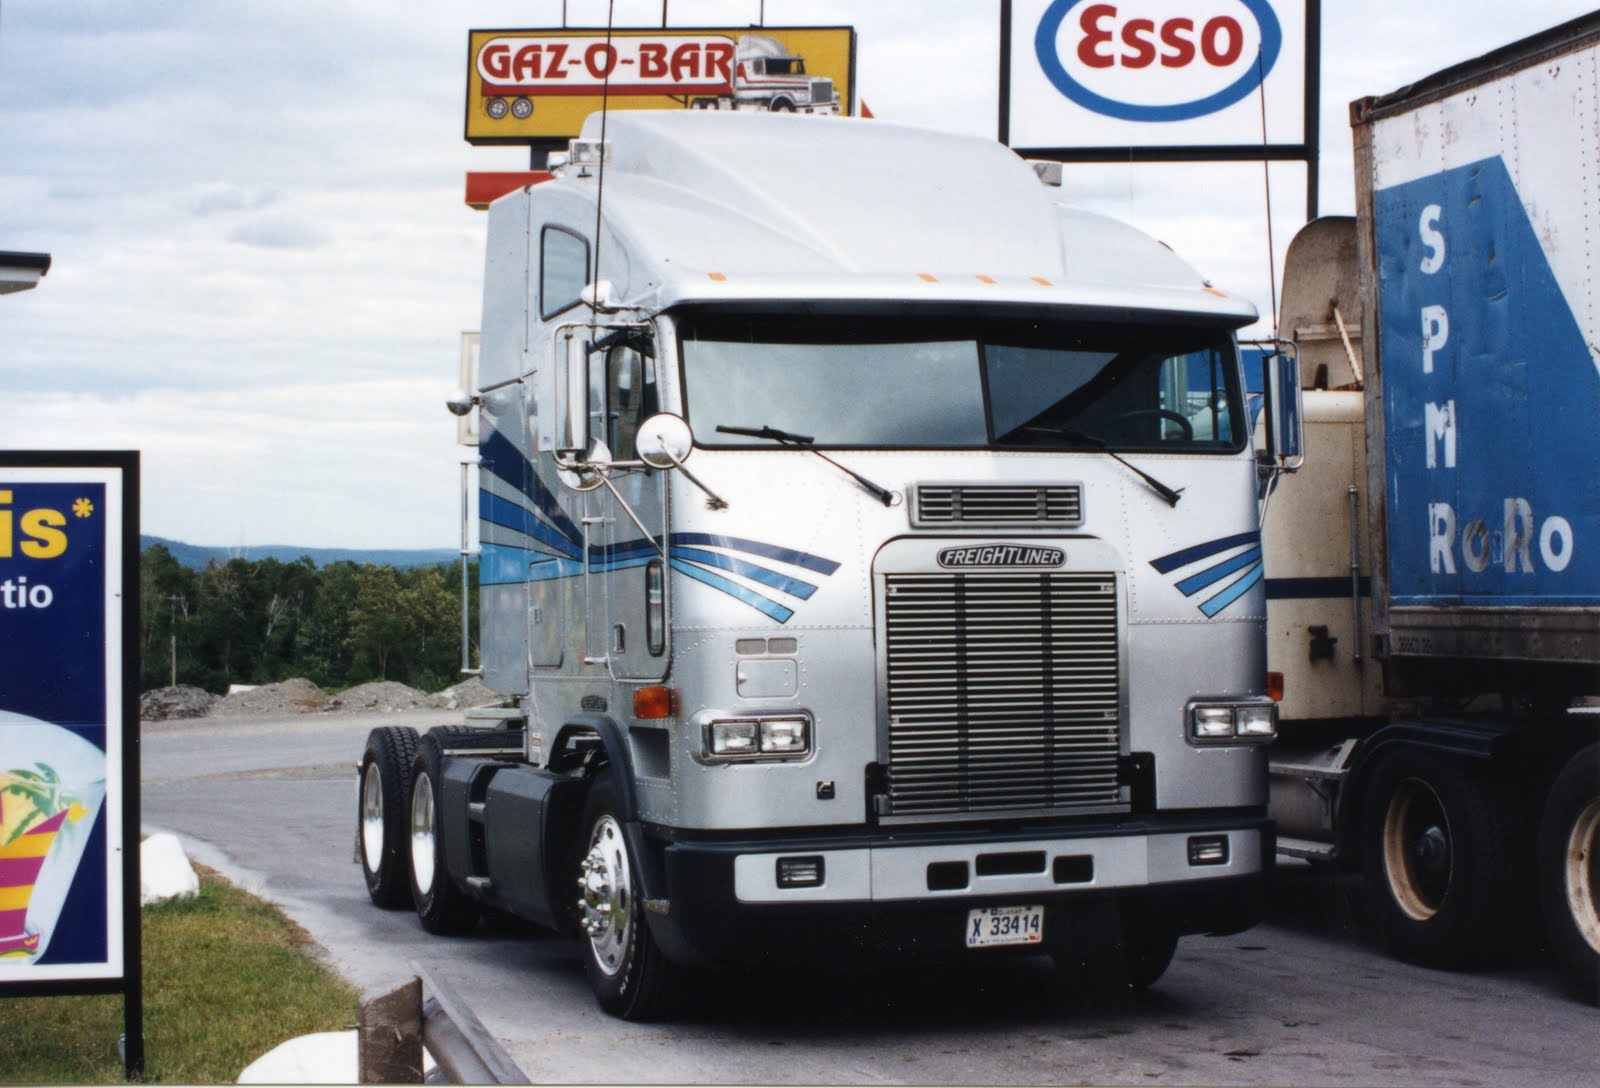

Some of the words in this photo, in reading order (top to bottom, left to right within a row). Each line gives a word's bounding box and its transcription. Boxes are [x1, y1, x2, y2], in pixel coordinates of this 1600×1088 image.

[1077, 4, 1243, 69] Esso
[482, 43, 736, 82] GAZ-O-BAR
[944, 547, 1061, 565] FREIGHTLINER
[972, 918, 982, 937] X
[990, 914, 1040, 936] 33414
